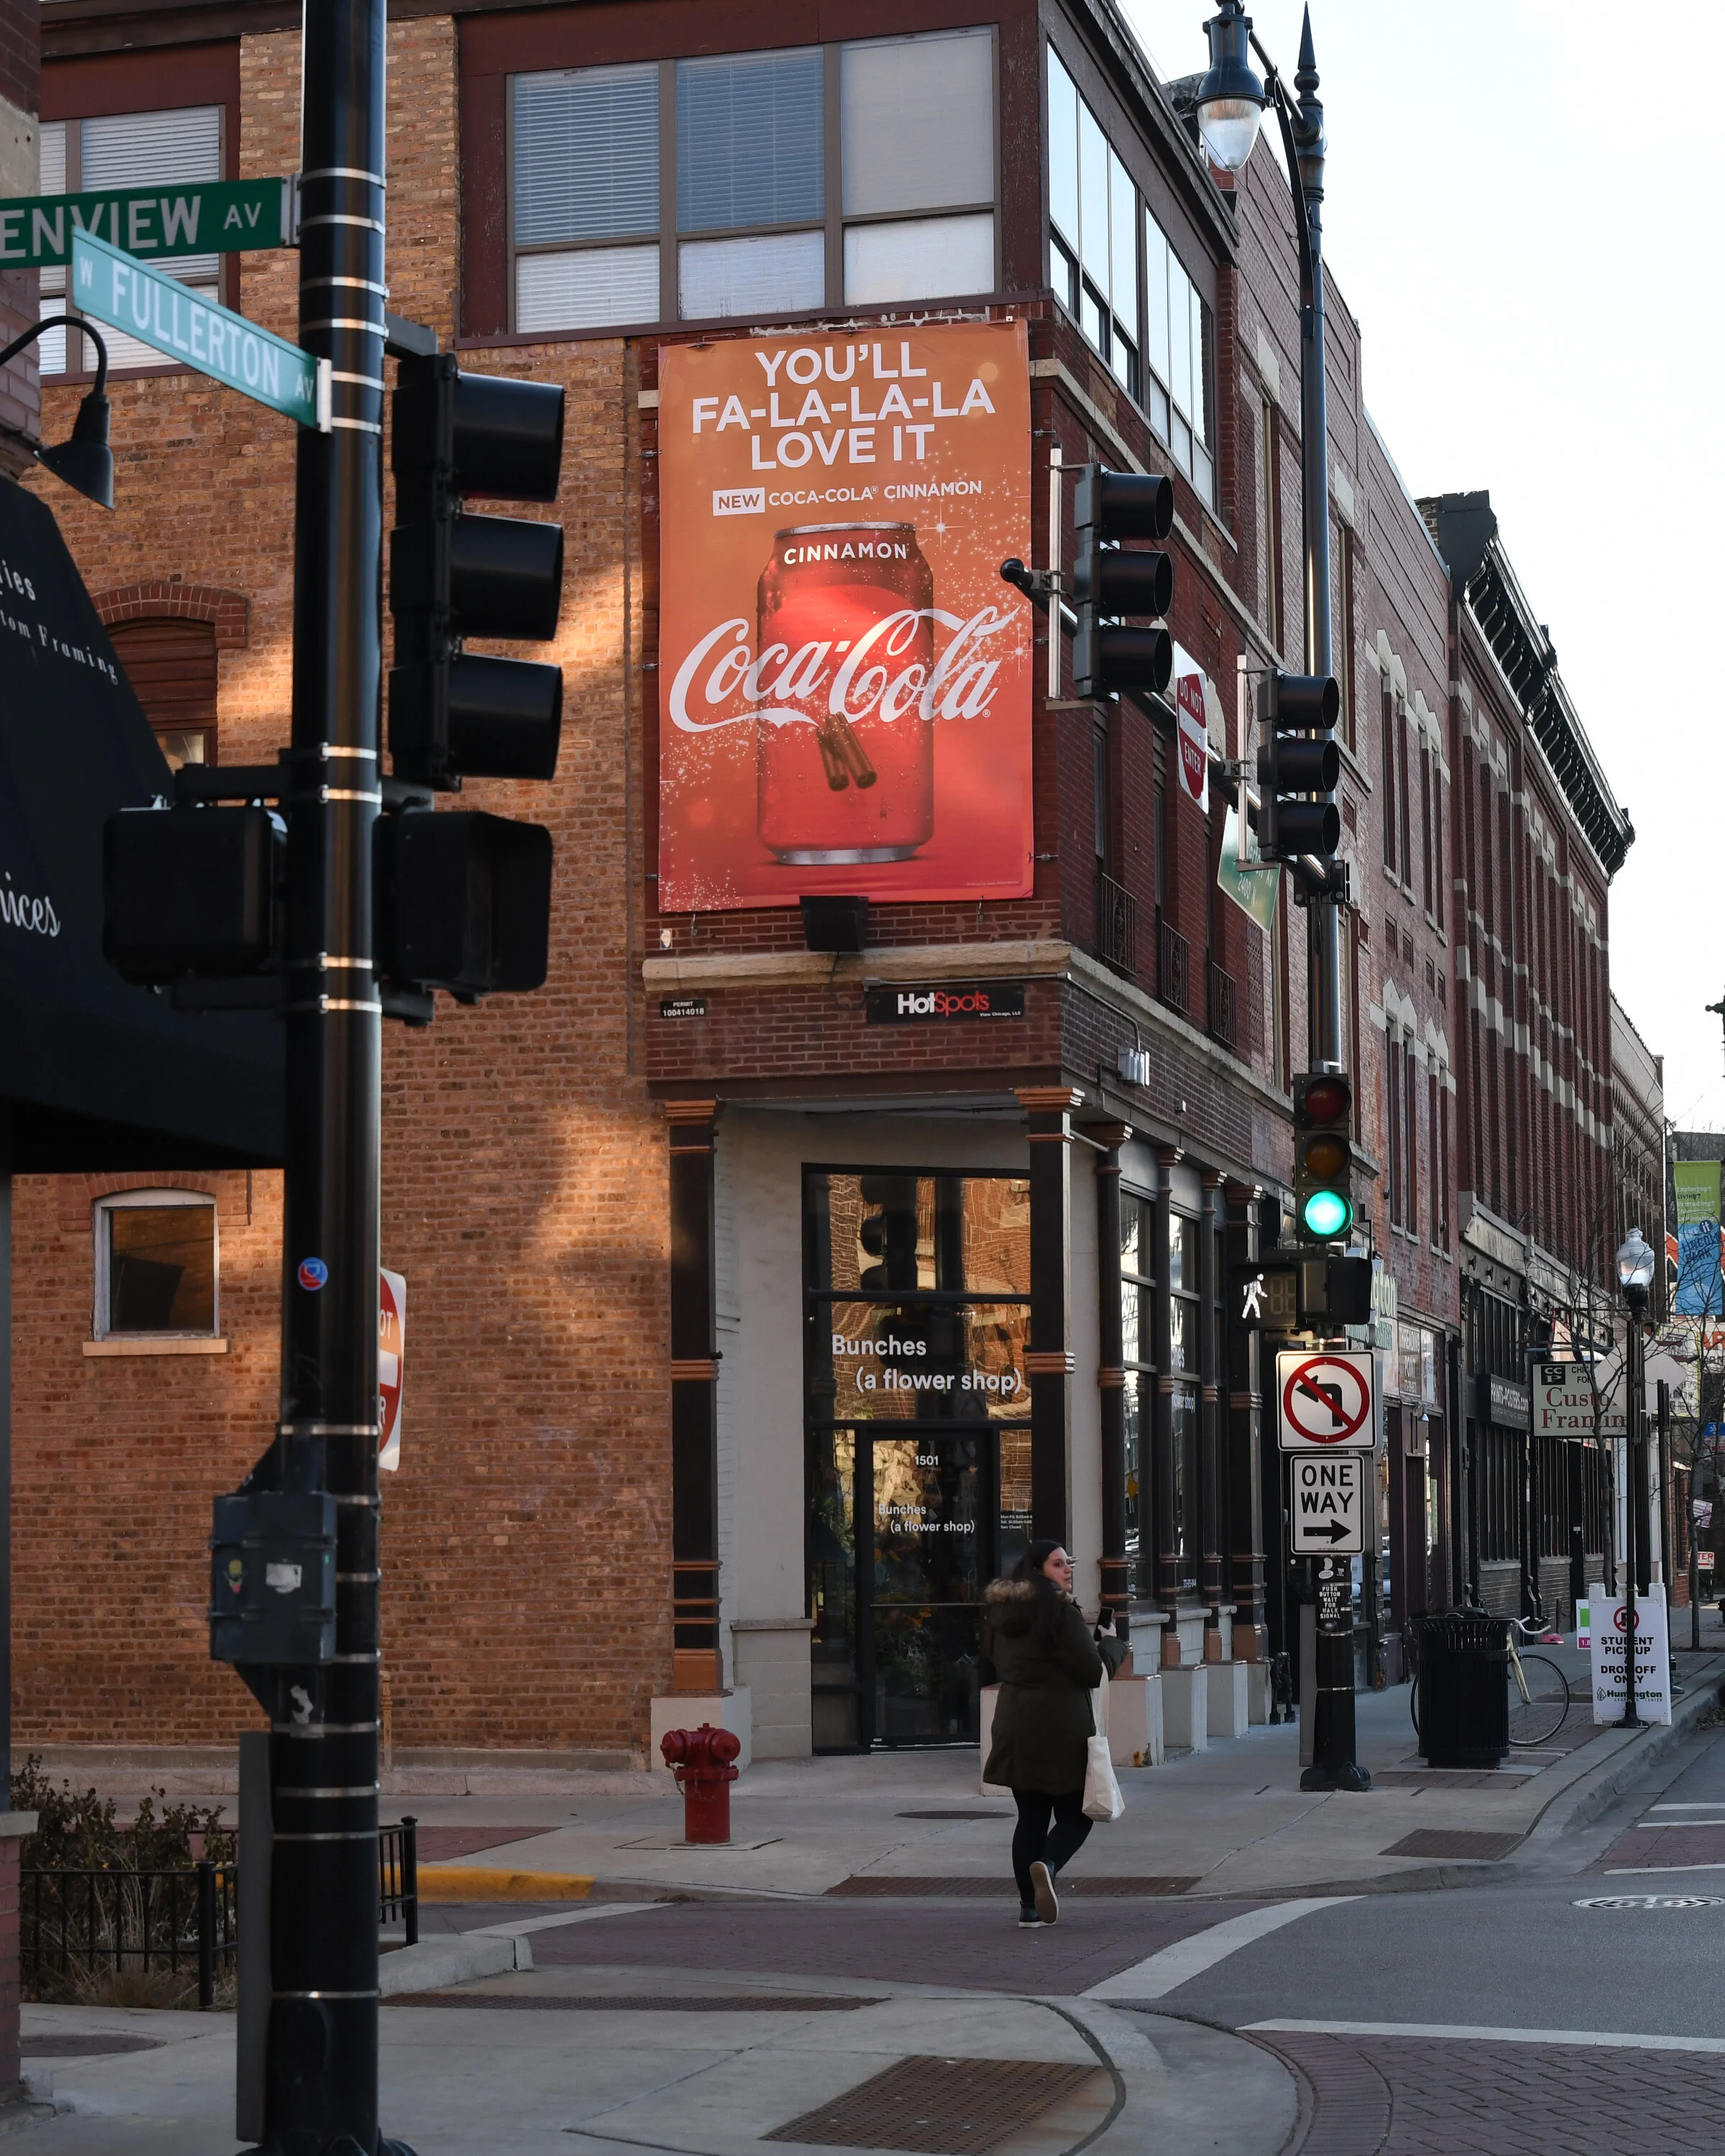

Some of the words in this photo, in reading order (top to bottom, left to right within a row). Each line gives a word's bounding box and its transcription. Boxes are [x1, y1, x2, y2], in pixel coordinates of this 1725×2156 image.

[223, 202, 262, 230] AV
[80, 256, 93, 288] W
[112, 259, 280, 400] FULLERTON
[295, 373, 315, 403] AV
[755, 341, 927, 387] YOU'LL
[692, 379, 995, 433] FA-LA-LA-LA
[751, 427, 876, 470] LOVE
[893, 424, 935, 461] IT
[717, 493, 760, 510] NEW
[884, 480, 982, 499] CINNAMON
[783, 543, 907, 565] CINNAMON
[0, 560, 36, 601] ies
[38, 623, 119, 686] Framing
[1179, 678, 1188, 702] DO
[1190, 688, 1202, 717] NOT
[1184, 741, 1202, 778] ENTER
[1238, 873, 1251, 900] 2400
[663, 1008, 704, 1017] 100414018
[832, 1334, 926, 1355] Bunches
[856, 1366, 876, 1393] (a
[883, 1368, 954, 1390] flower
[961, 1367, 1021, 1395] shop)
[1547, 1387, 1617, 1407] Custo
[914, 1455, 939, 1466] 1501
[1302, 1465, 1353, 1486] ONE
[878, 1503, 926, 1515] Bunches
[1300, 1492, 1354, 1514] WAY
[891, 1519, 901, 1534] (a
[904, 1519, 941, 1532] flower
[944, 1519, 975, 1534] shop)
